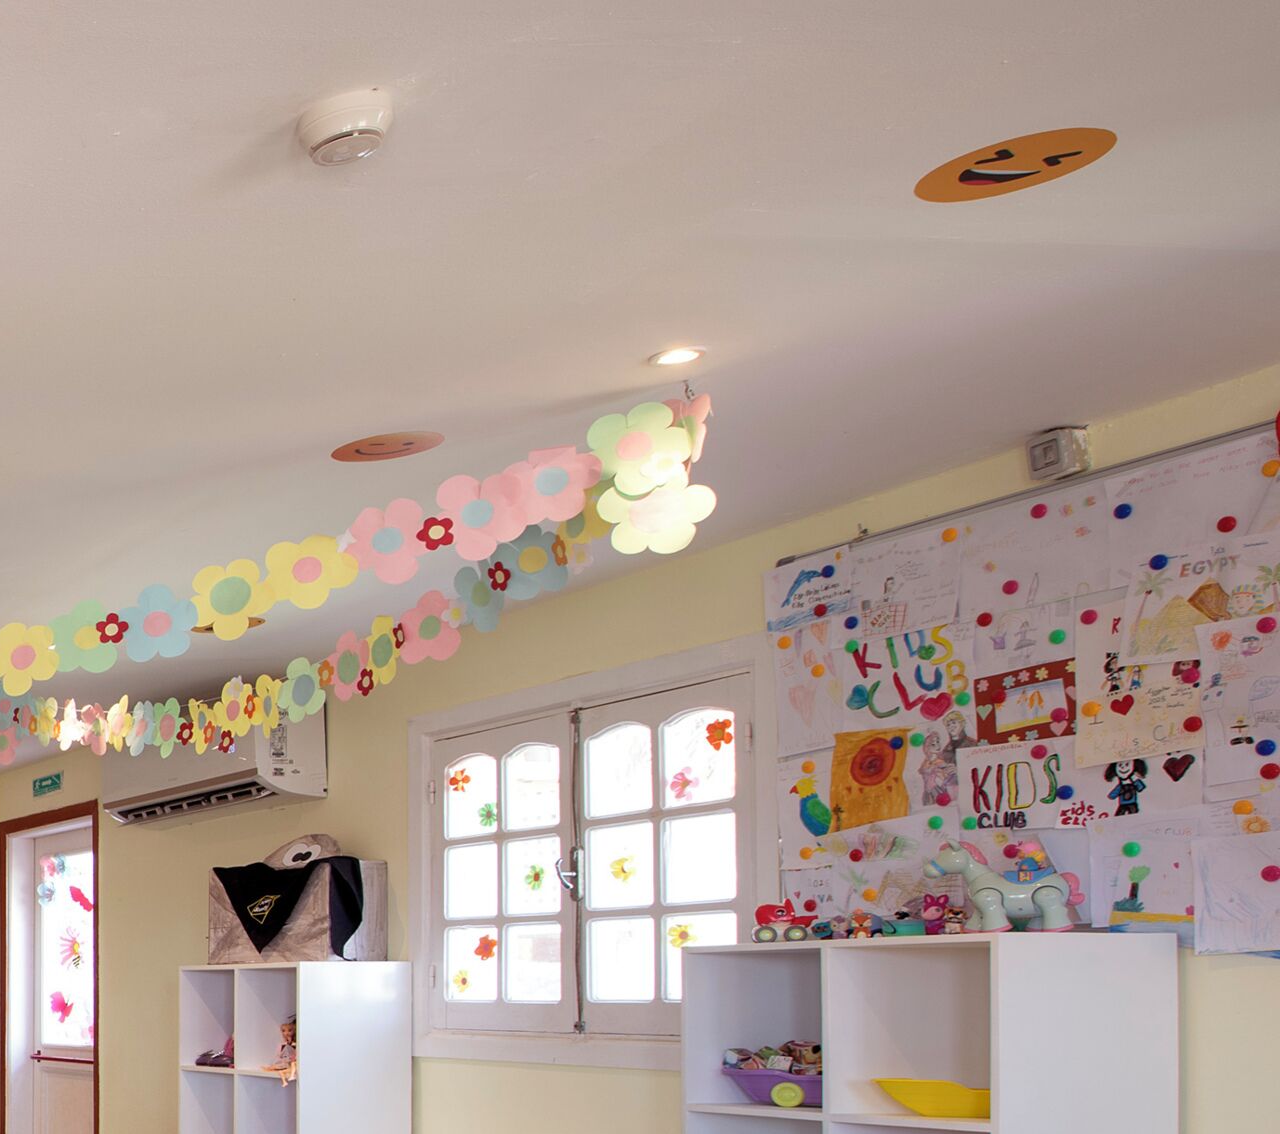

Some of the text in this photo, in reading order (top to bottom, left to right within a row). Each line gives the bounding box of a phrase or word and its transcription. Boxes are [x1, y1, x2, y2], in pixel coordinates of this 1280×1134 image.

[1179, 555, 1239, 578] EGYPT
[852, 623, 953, 679] KIDS
[868, 659, 969, 719] CLUB
[971, 753, 1061, 813] KIDS
[977, 811, 1027, 830] CLUB
